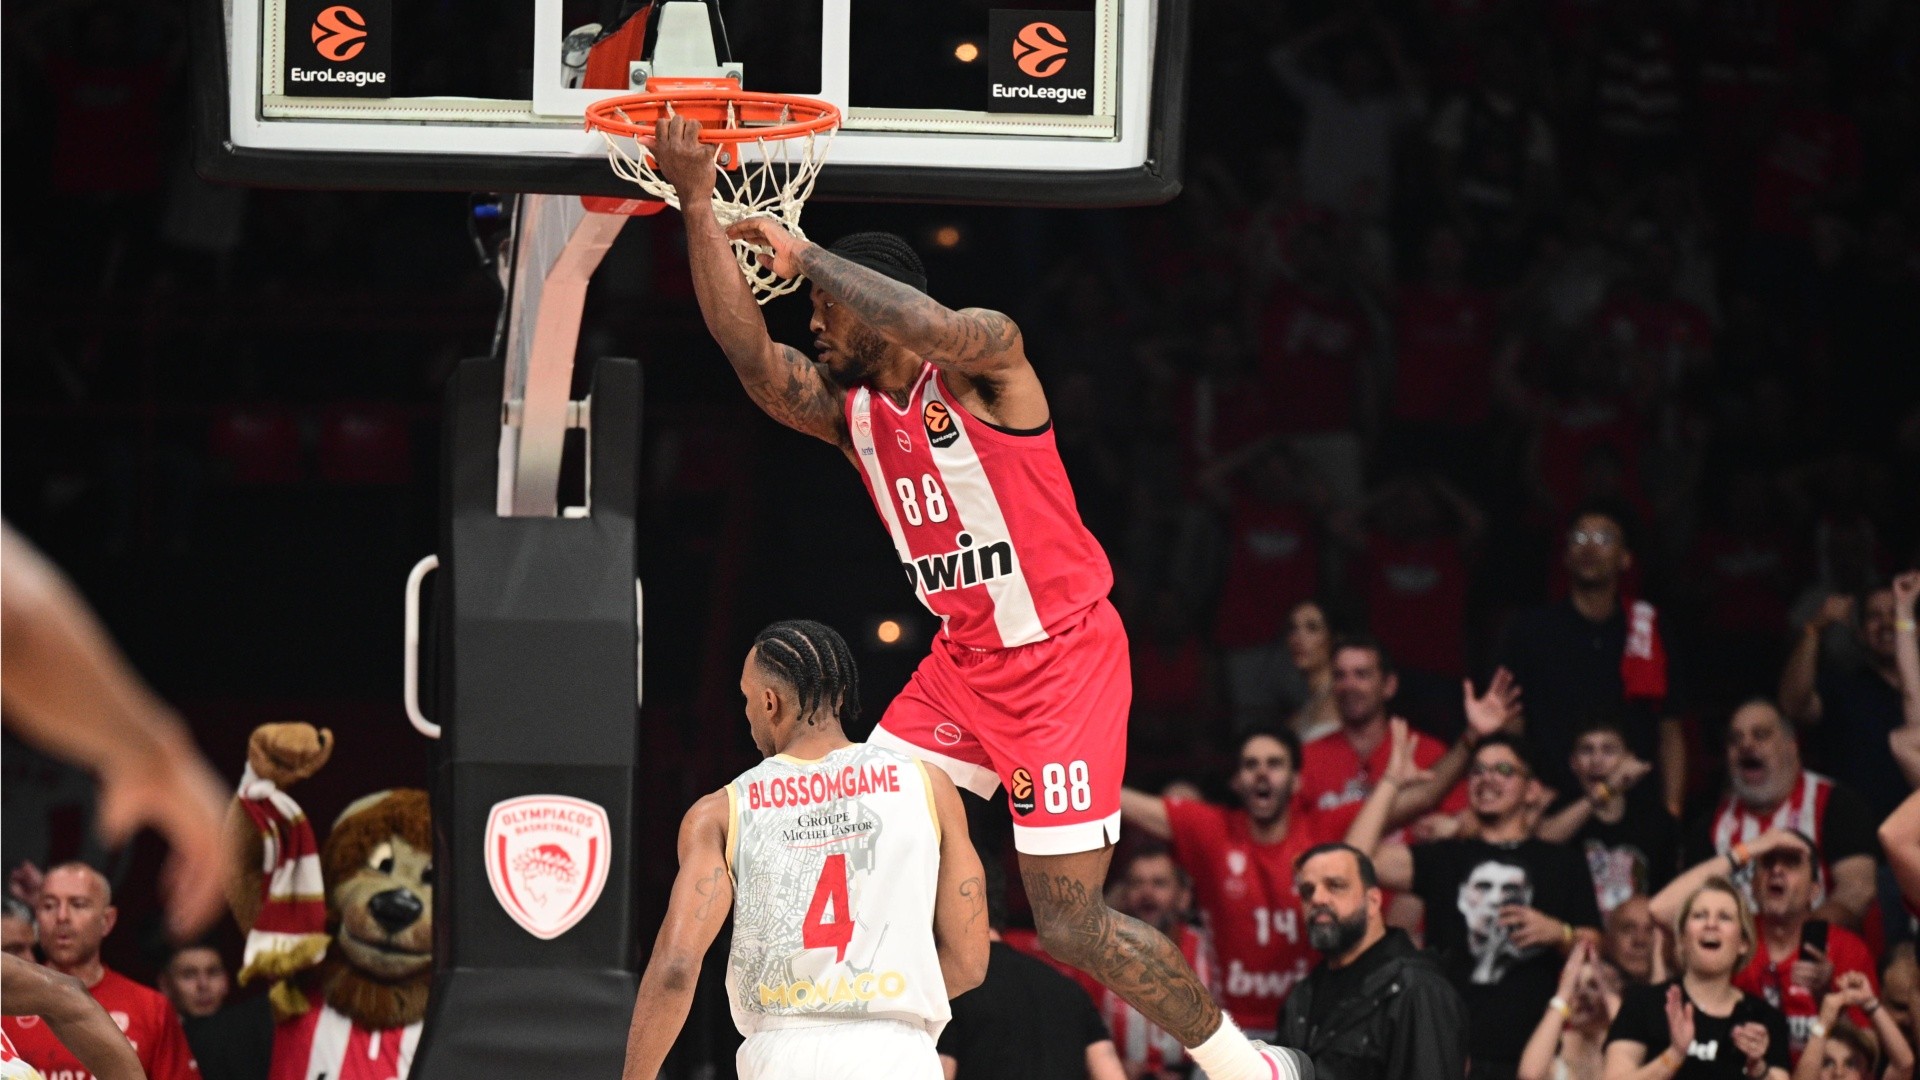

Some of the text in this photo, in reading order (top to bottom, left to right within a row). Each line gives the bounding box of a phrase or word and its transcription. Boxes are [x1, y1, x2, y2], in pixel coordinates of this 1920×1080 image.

[290, 67, 386, 87] EuroLeague
[992, 83, 1087, 103] EuroLeague
[895, 473, 949, 527] 88
[748, 764, 900, 810] BLOSSOMGAME
[1042, 759, 1092, 814] 88
[502, 808, 593, 828] OLYMPIACOS
[782, 821, 873, 842] MICHEL PASTOR
[797, 812, 851, 828] GROUPE
[802, 853, 856, 965] 4
[1253, 906, 1300, 948] 14
[758, 969, 907, 1009] MONACO
